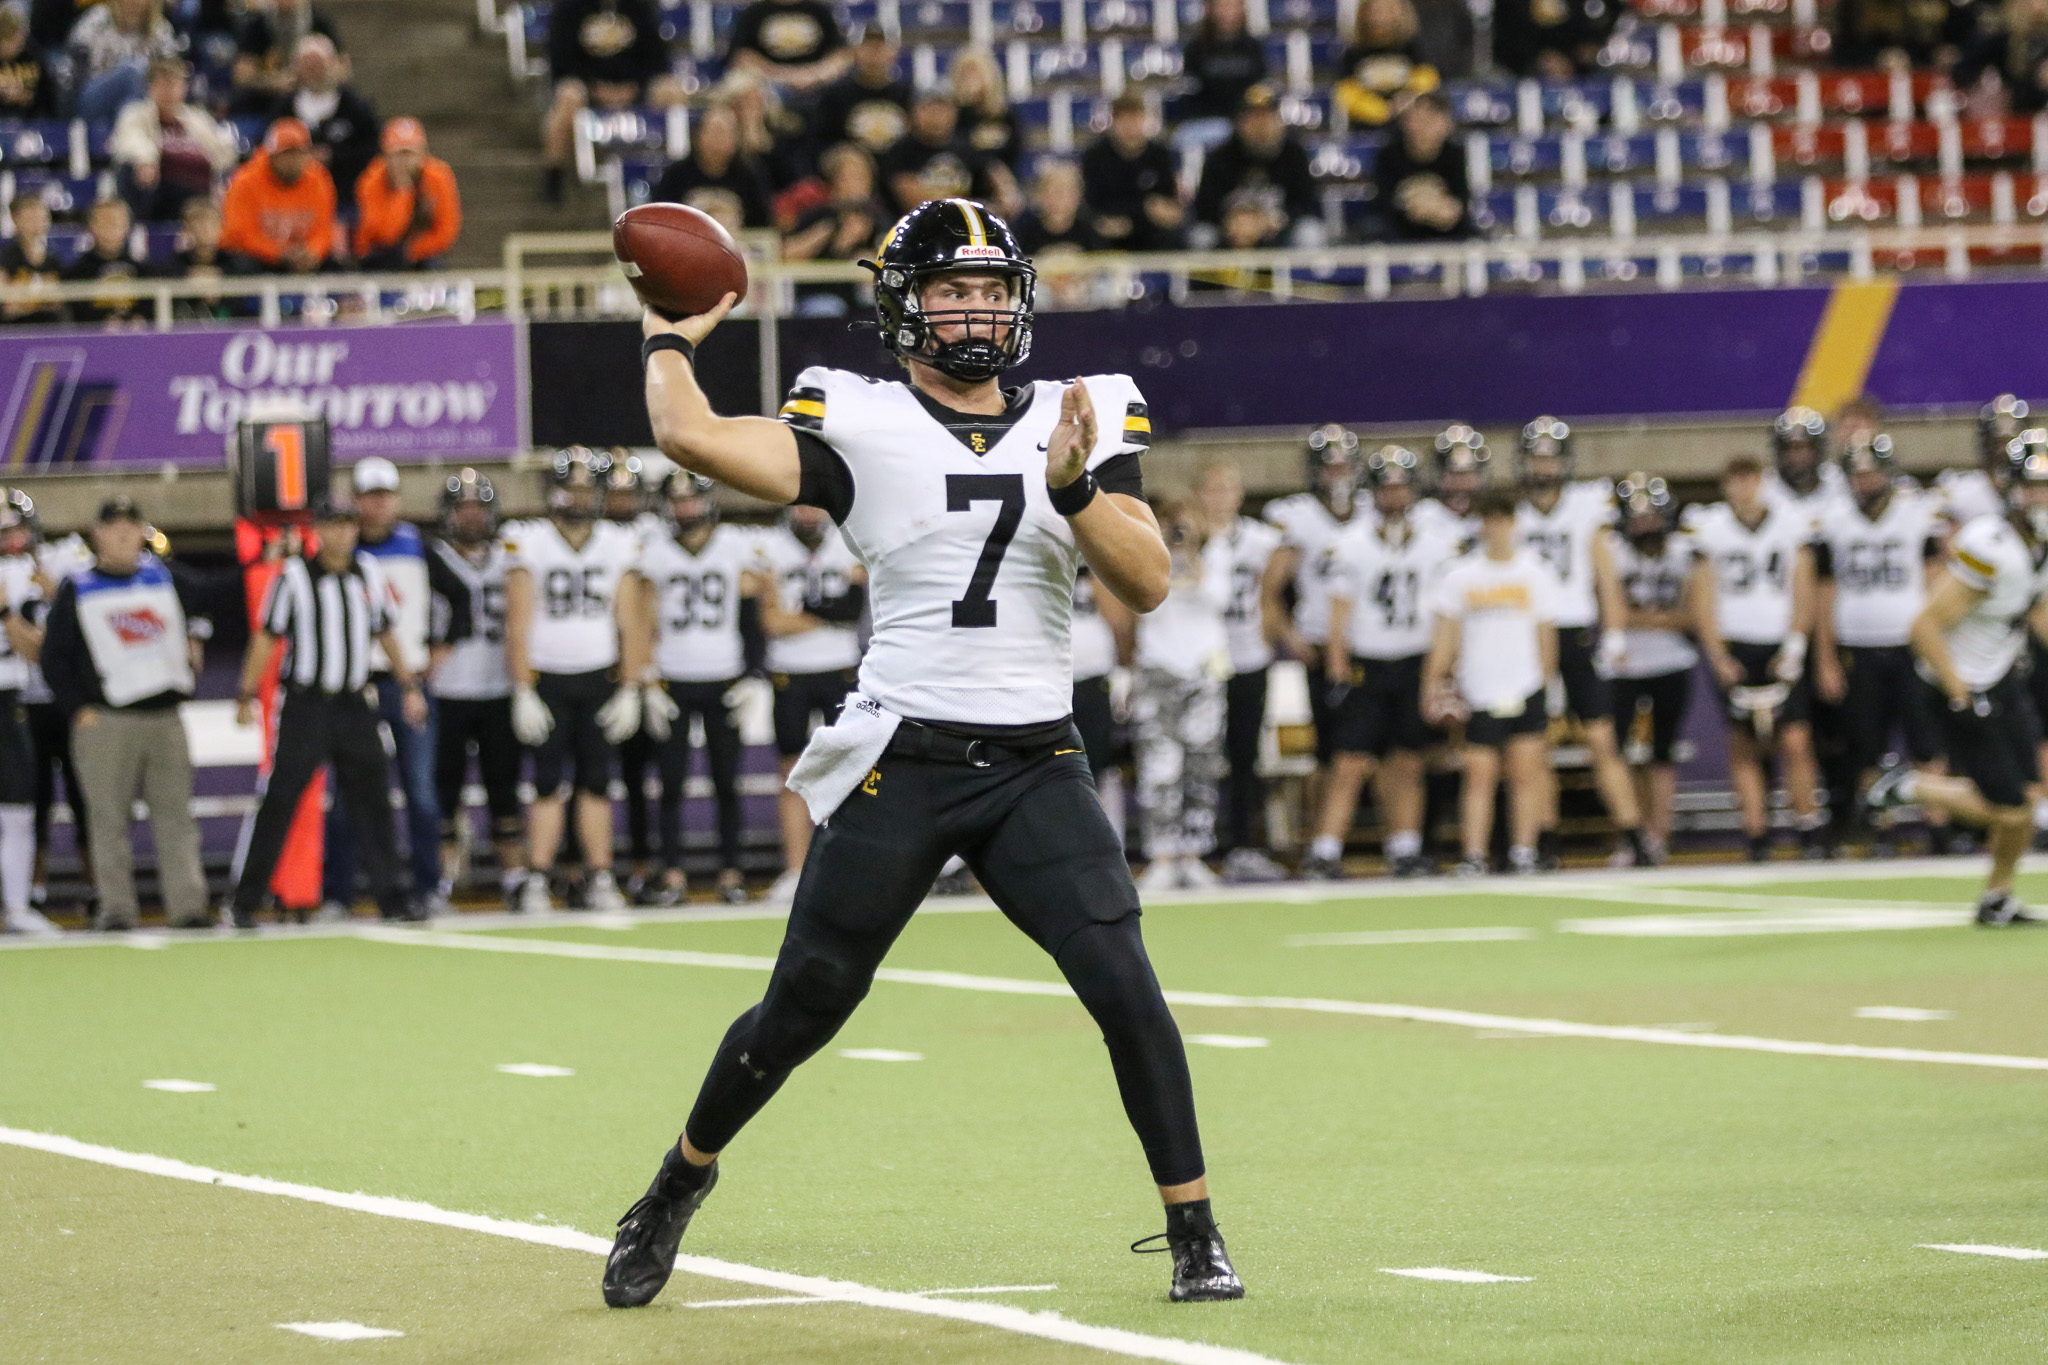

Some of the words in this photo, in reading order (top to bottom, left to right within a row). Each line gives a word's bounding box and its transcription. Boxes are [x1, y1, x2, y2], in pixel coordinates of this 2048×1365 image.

[961, 247, 1001, 257] Riddell
[221, 332, 349, 388] Our
[168, 379, 497, 434] Toorrow
[264, 422, 307, 510] 1
[945, 473, 1026, 628] 7
[546, 566, 608, 618] 85
[665, 570, 728, 631] 39
[1373, 570, 1417, 628] 41
[856, 702, 881, 718] adidas
